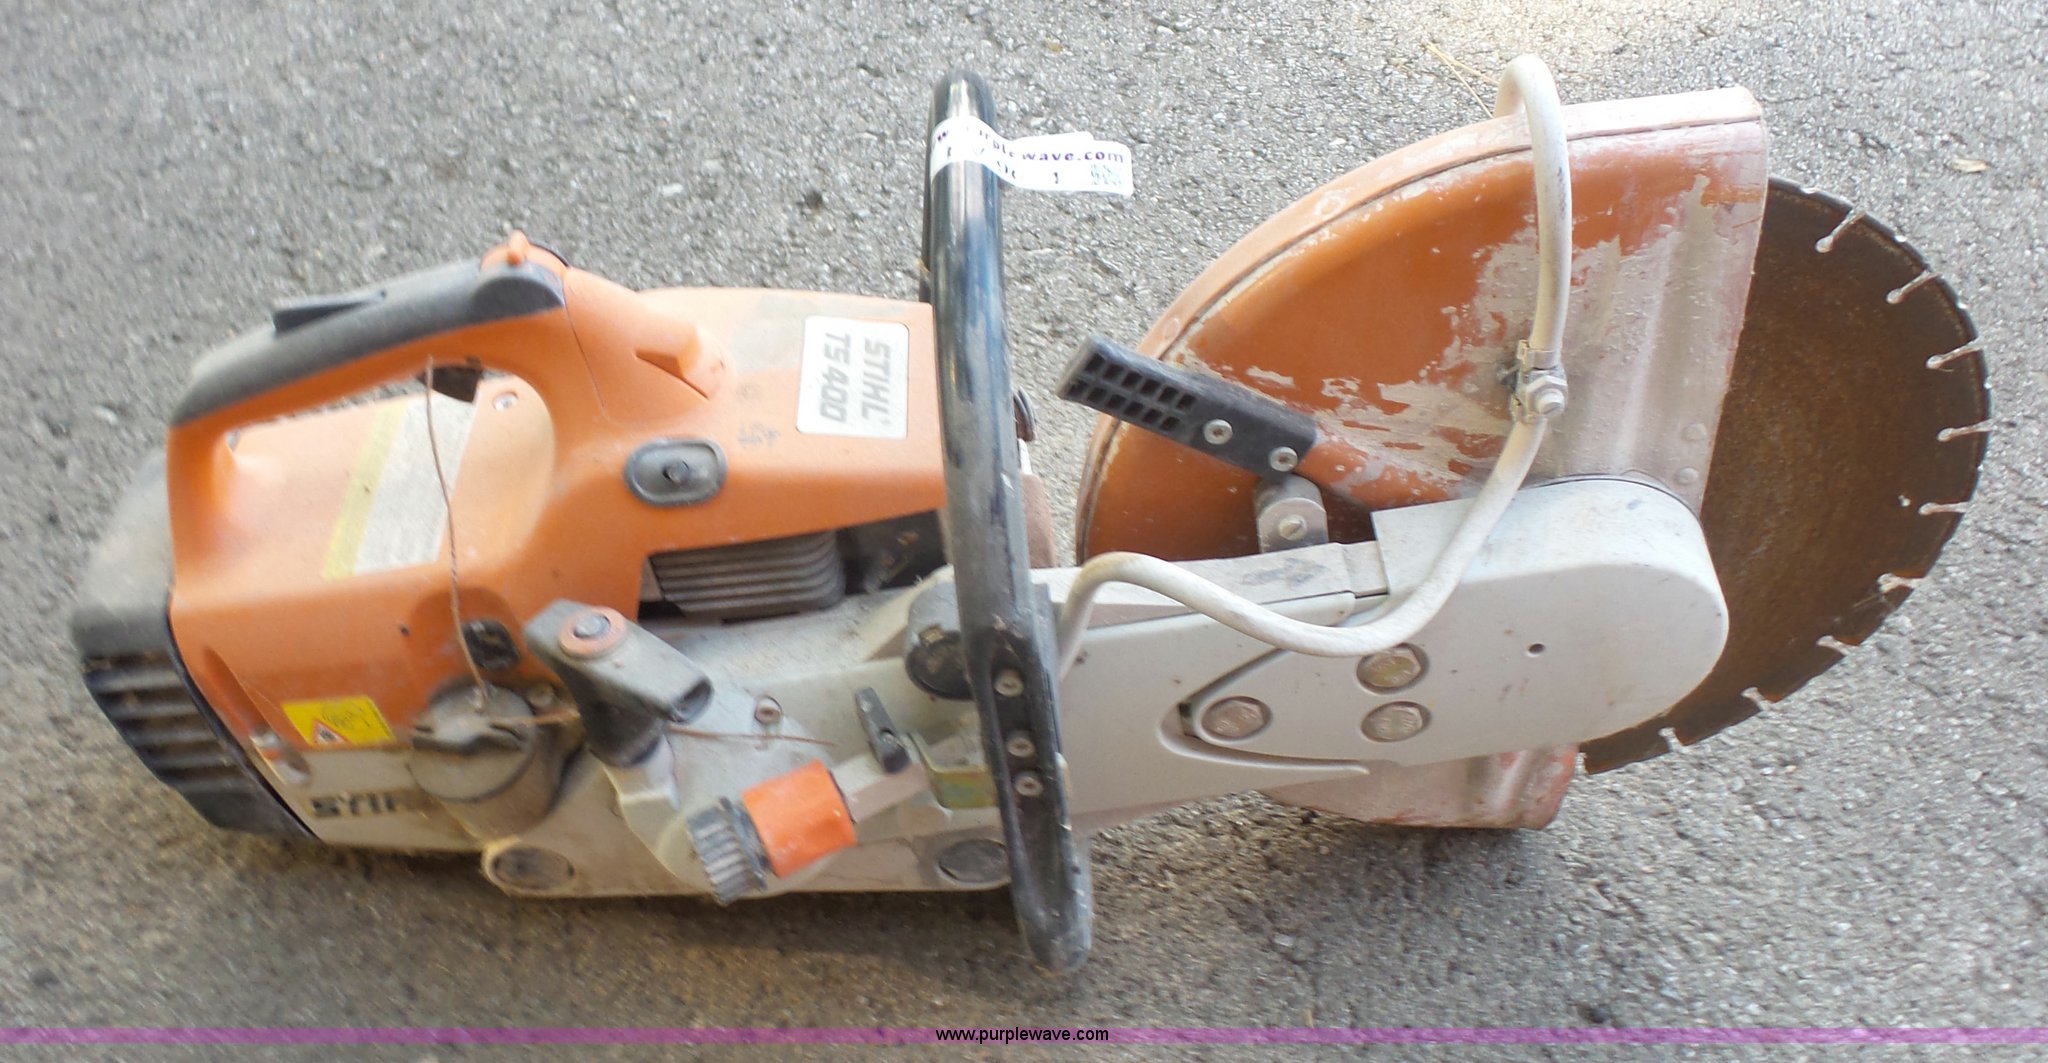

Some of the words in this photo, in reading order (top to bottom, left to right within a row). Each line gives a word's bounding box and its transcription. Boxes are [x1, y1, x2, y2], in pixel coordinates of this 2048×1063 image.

[824, 332, 850, 365] TS
[819, 366, 849, 423] 400
[861, 338, 891, 420] STIHL
